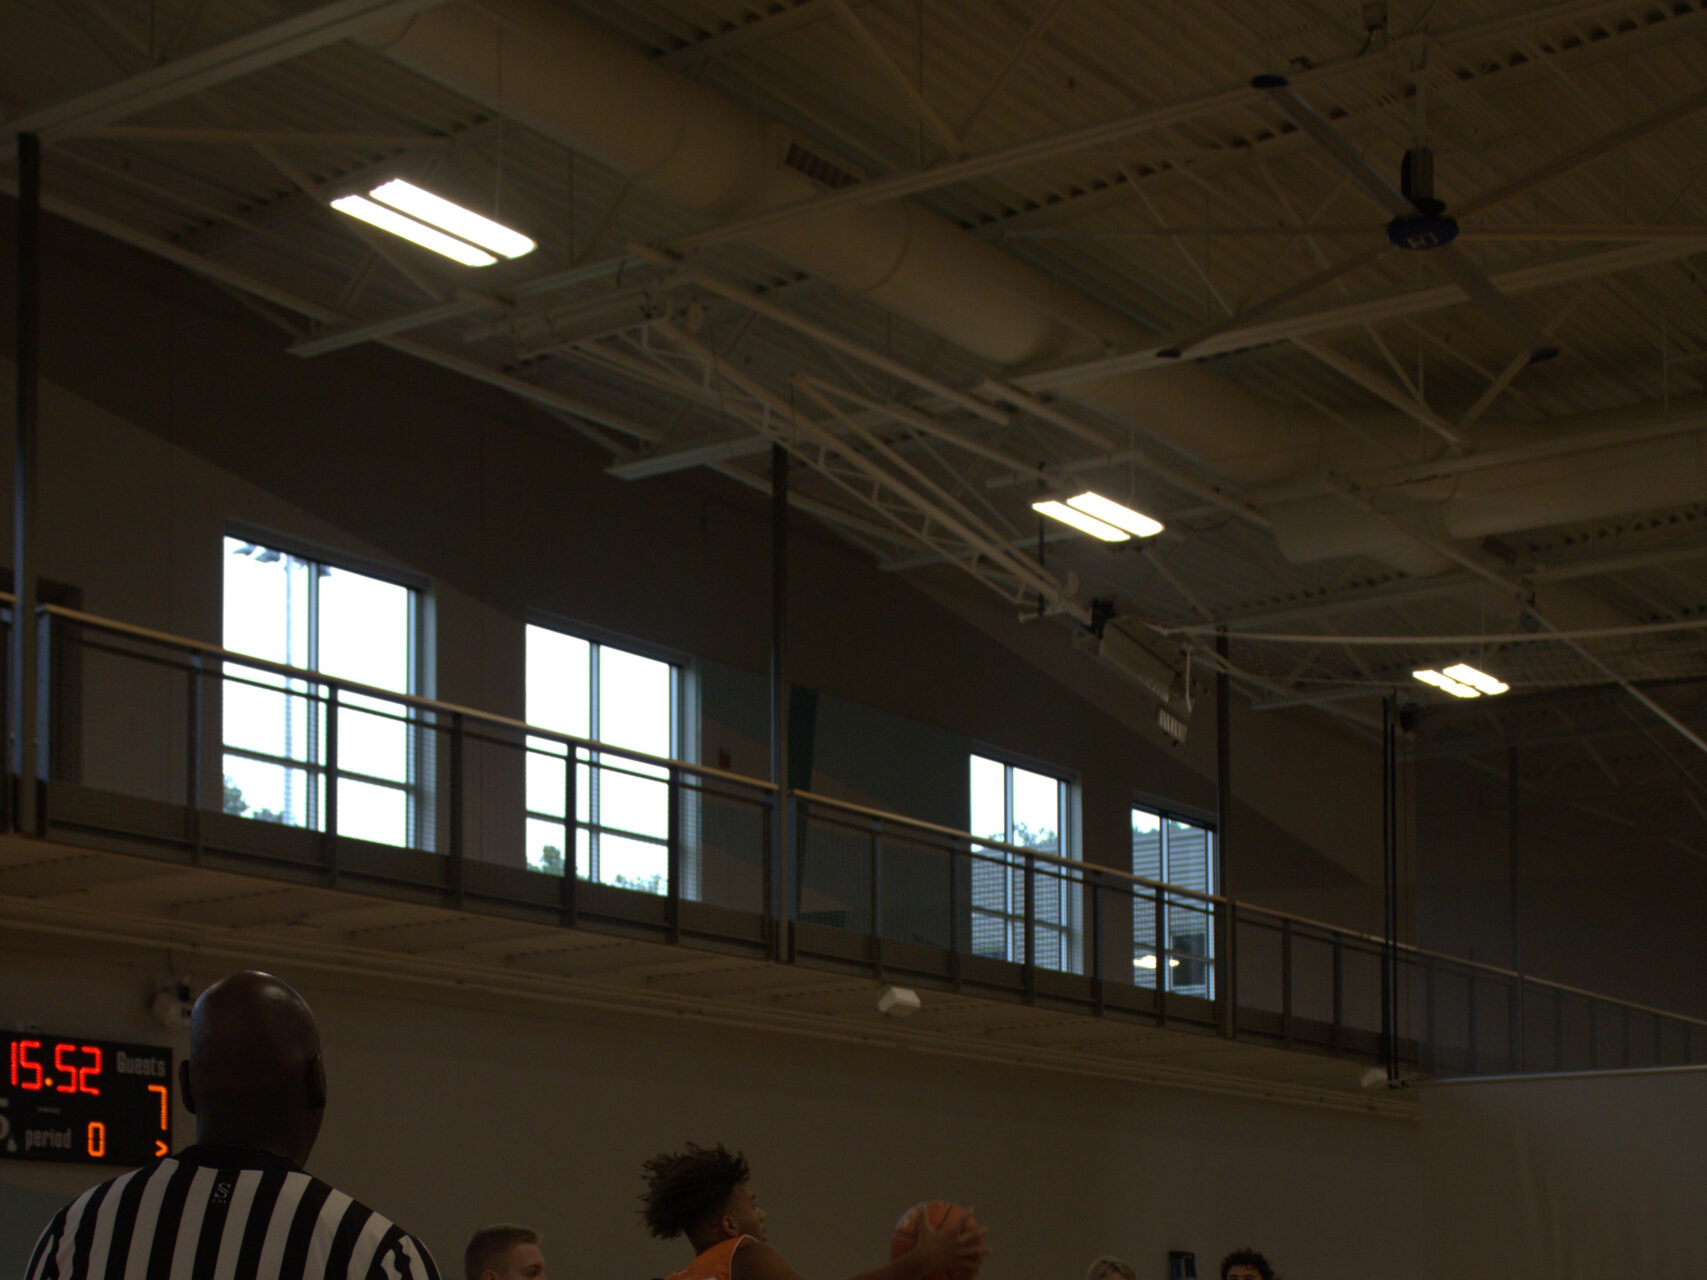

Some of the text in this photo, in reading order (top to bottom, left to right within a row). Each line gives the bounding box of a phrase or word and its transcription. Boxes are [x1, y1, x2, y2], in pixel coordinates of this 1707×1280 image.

[115, 1050, 167, 1077] Guests
[147, 1083, 168, 1132] 7
[25, 1120, 107, 1158] period 0
